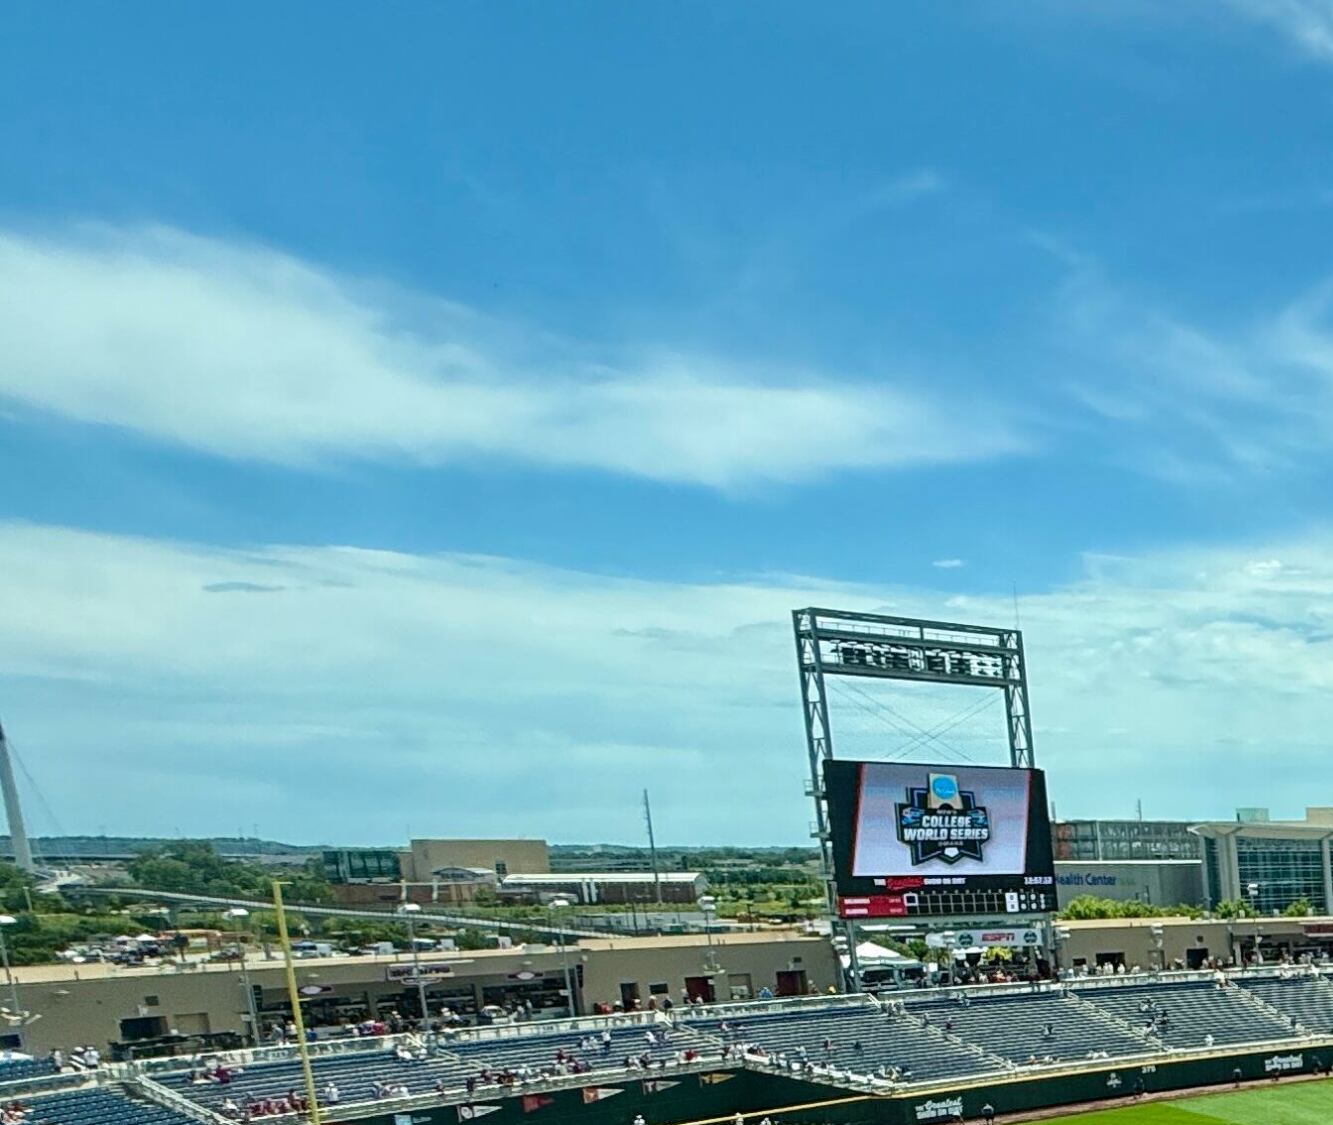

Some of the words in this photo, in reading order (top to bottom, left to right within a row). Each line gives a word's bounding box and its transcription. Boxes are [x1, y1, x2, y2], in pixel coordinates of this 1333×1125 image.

[922, 816, 971, 828] COLLEGE
[904, 828, 947, 840] WORLD
[949, 828, 988, 840] SERIES
[1086, 873, 1117, 885] Center
